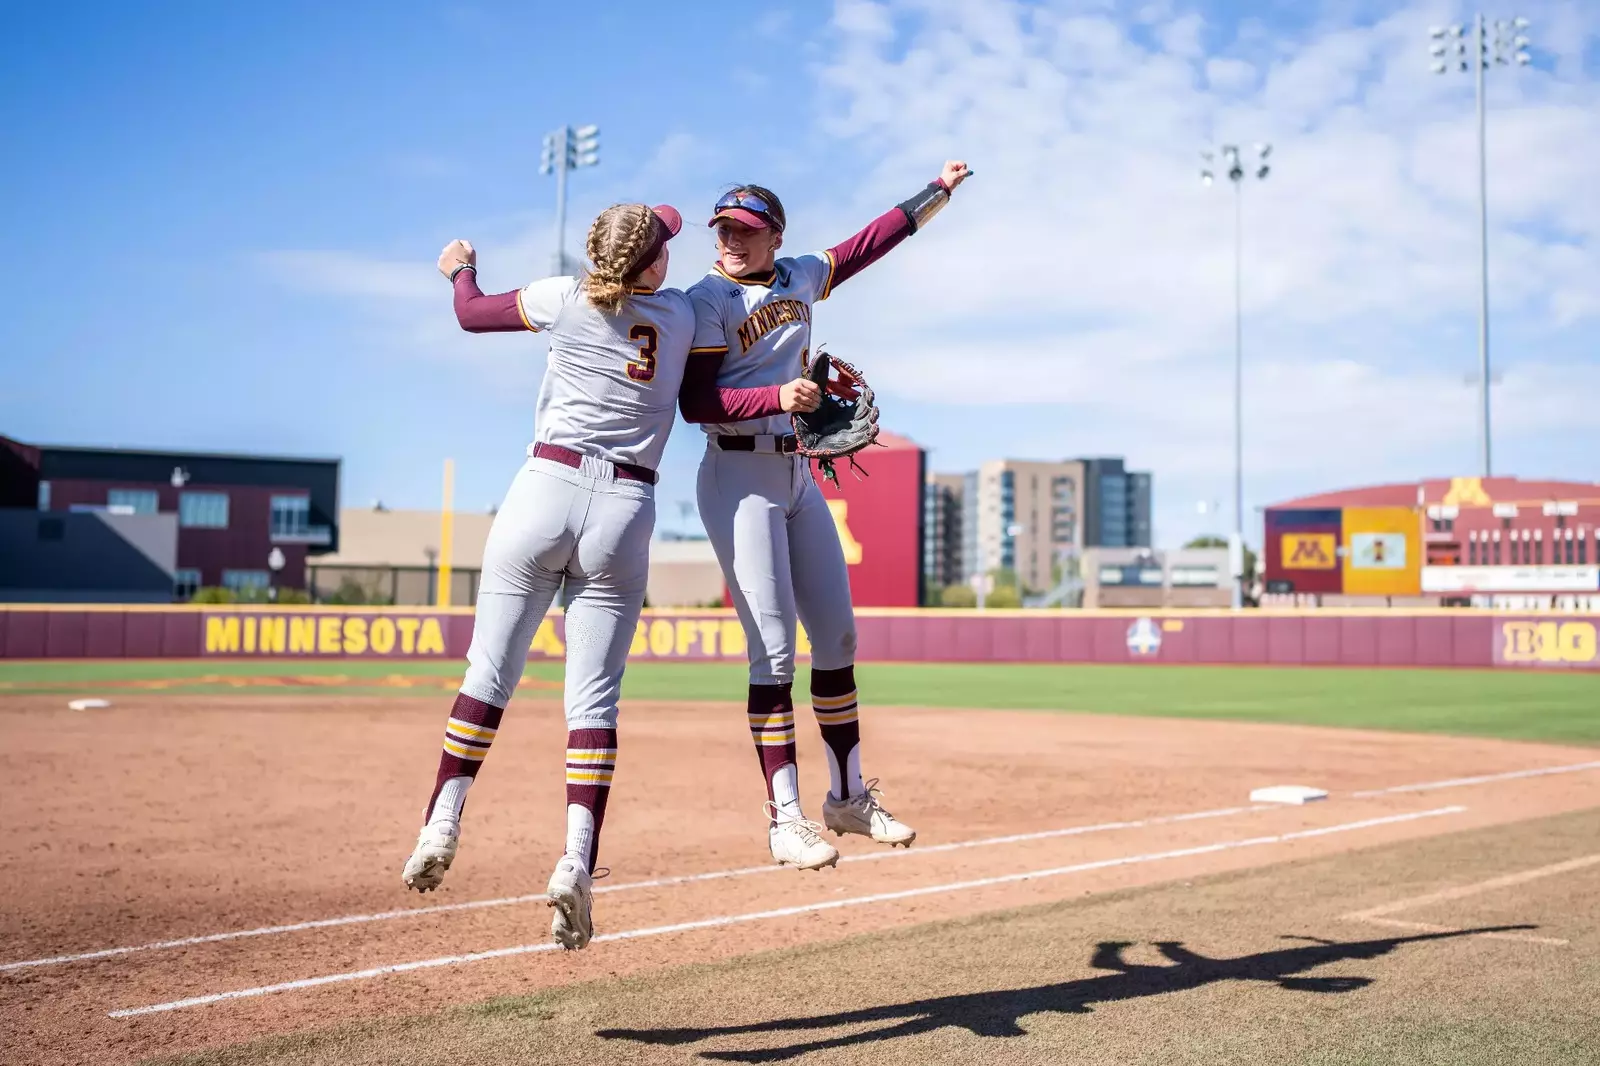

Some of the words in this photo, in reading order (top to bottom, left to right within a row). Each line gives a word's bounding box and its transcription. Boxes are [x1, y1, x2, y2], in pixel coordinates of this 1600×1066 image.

[625, 324, 659, 382] 3
[1290, 540, 1329, 563] M
[206, 616, 446, 654] MINNESOTA
[629, 618, 811, 657] SOFTB
